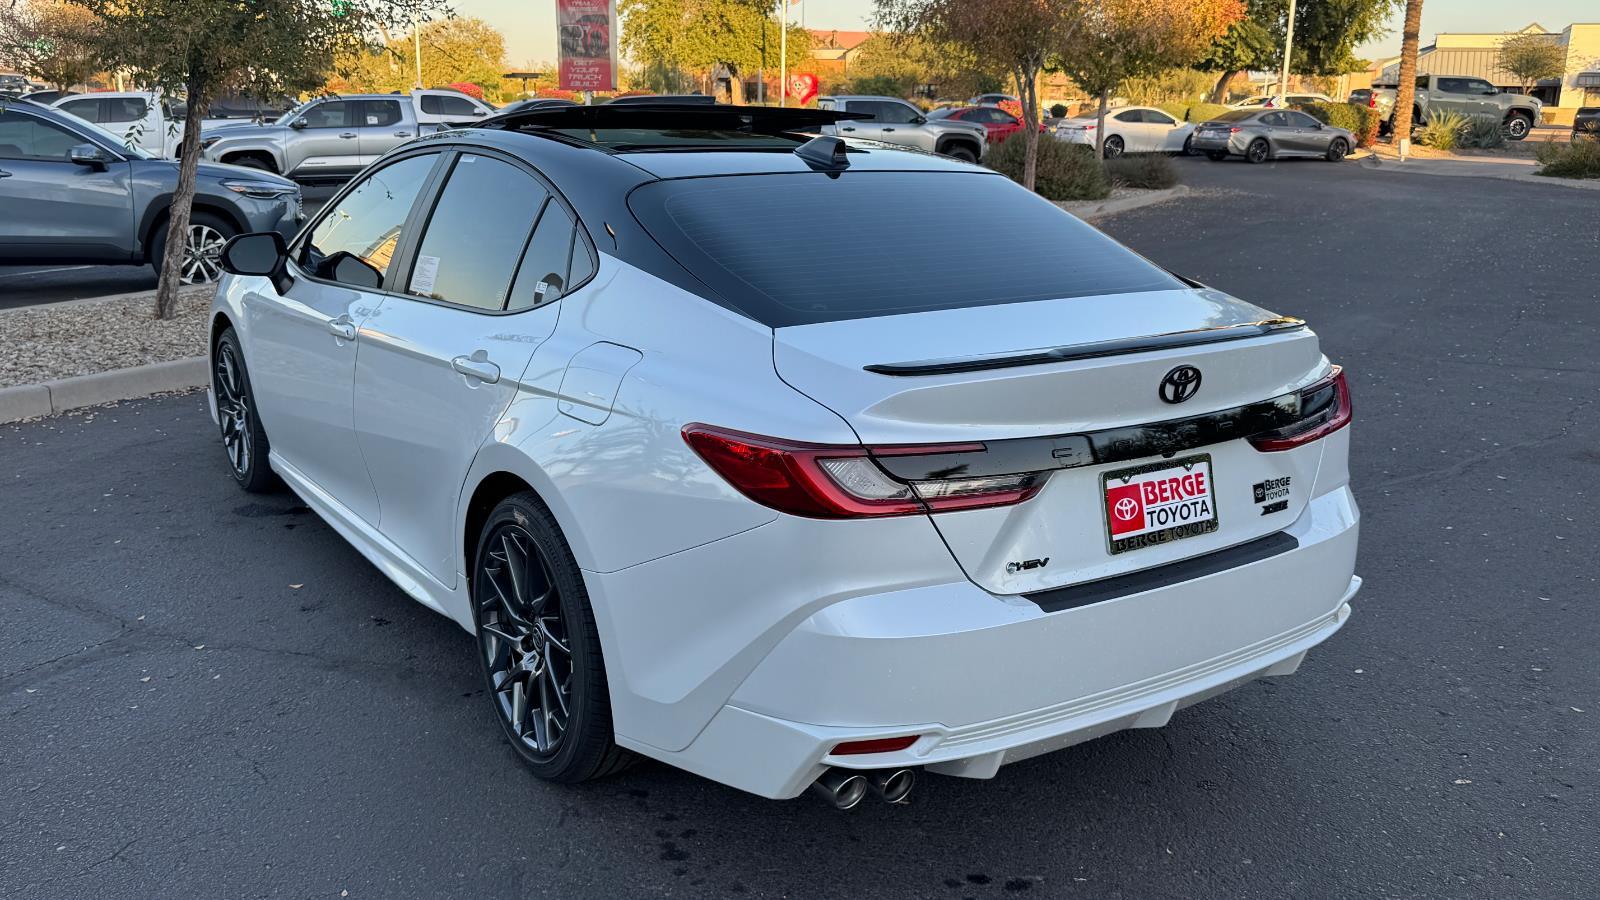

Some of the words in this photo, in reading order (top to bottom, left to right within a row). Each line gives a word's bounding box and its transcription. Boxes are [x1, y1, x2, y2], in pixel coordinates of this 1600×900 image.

[1142, 472, 1207, 506] BERGE
[1264, 476, 1292, 491] BERGE
[1265, 487, 1290, 501] TOYOTA
[1146, 499, 1211, 528] TOYOTA
[1115, 529, 1167, 552] BERGE
[1169, 520, 1214, 540] TOYOTA
